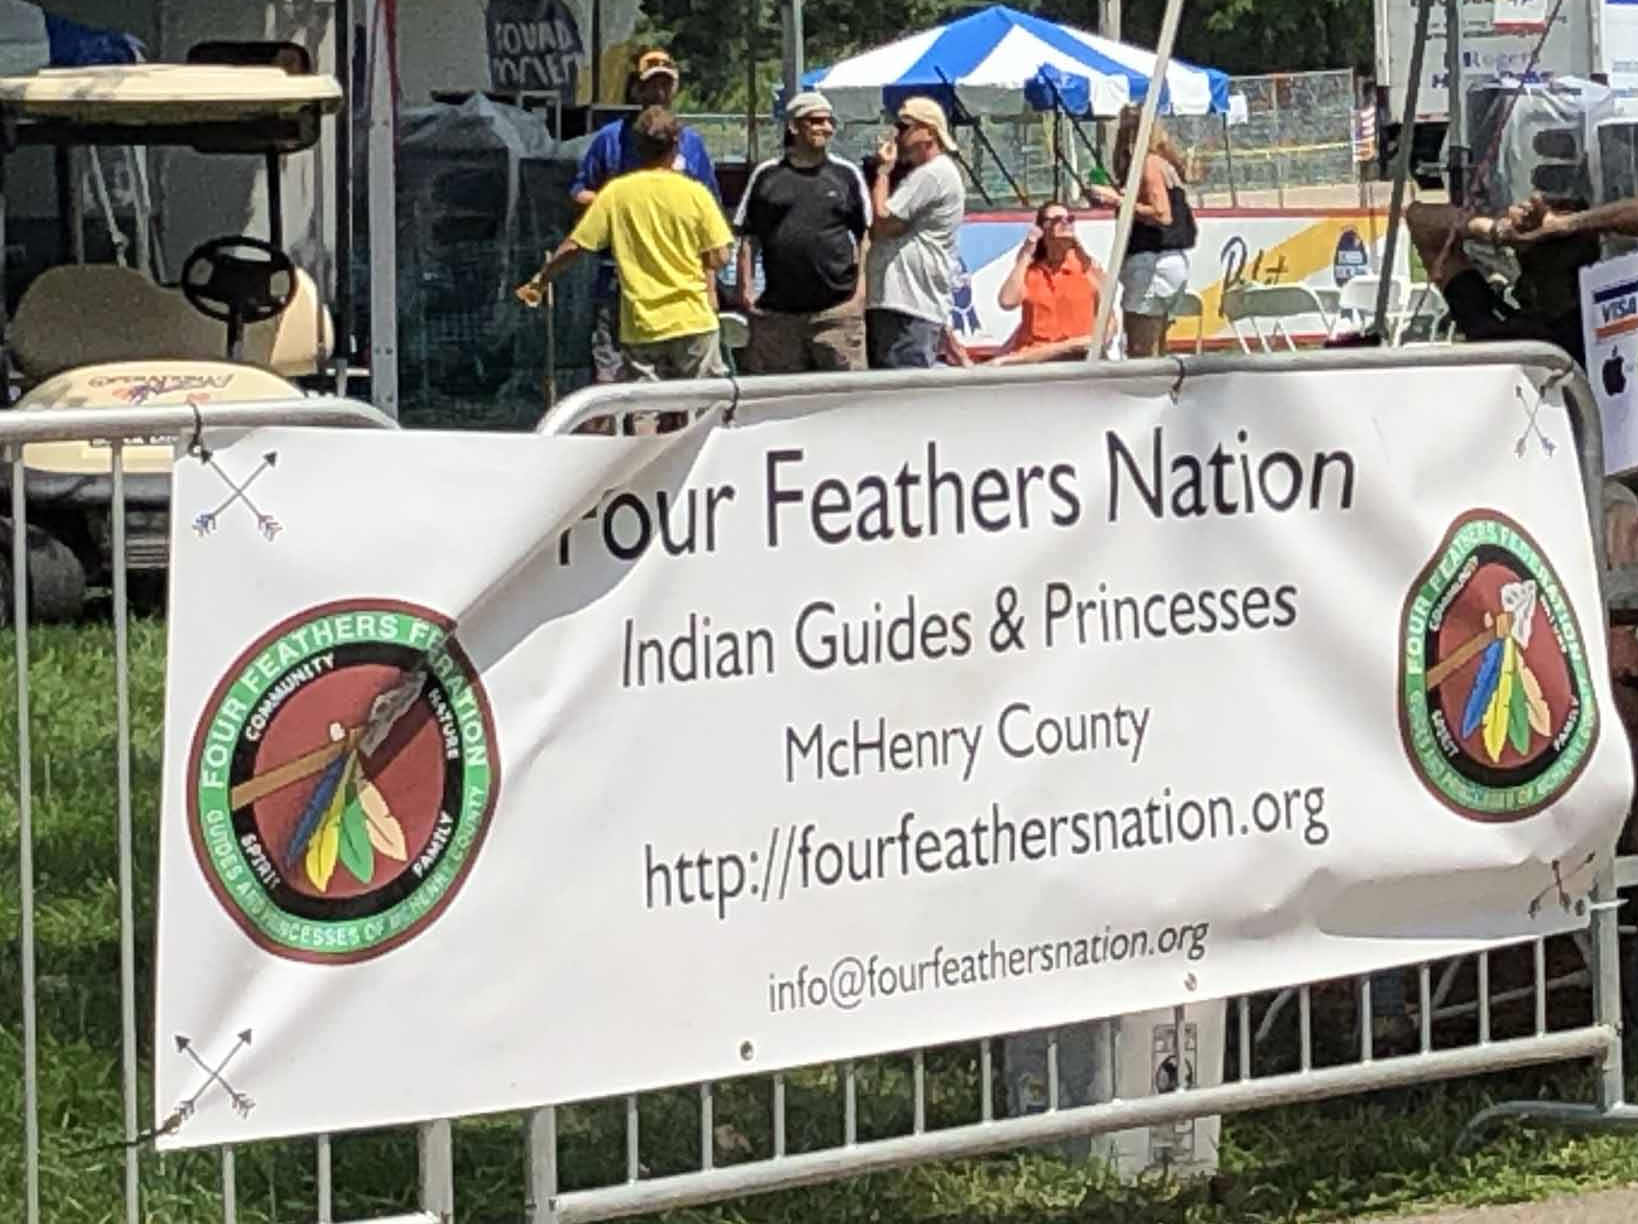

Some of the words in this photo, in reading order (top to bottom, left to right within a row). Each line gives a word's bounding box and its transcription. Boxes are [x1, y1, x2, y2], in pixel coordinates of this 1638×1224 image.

[1600, 295, 1638, 324] VISA
[765, 440, 1081, 548] Feathers
[1105, 426, 1355, 523] Nation
[622, 613, 775, 688] Indian
[795, 594, 972, 670] Guides
[989, 586, 1025, 653] &
[1045, 581, 1298, 648] Princesses
[203, 696, 248, 789] FOUR
[242, 614, 399, 695] FEATHERS
[245, 652, 335, 742] COMMUNITY
[785, 717, 983, 782] McHenry
[997, 702, 1150, 763] County
[205, 809, 244, 880] GUIDES
[412, 809, 455, 878] FAMILY
[644, 785, 1329, 919] http://fourfeathersnation.org
[769, 920, 1209, 1012] info@fourfeathersnation.org
